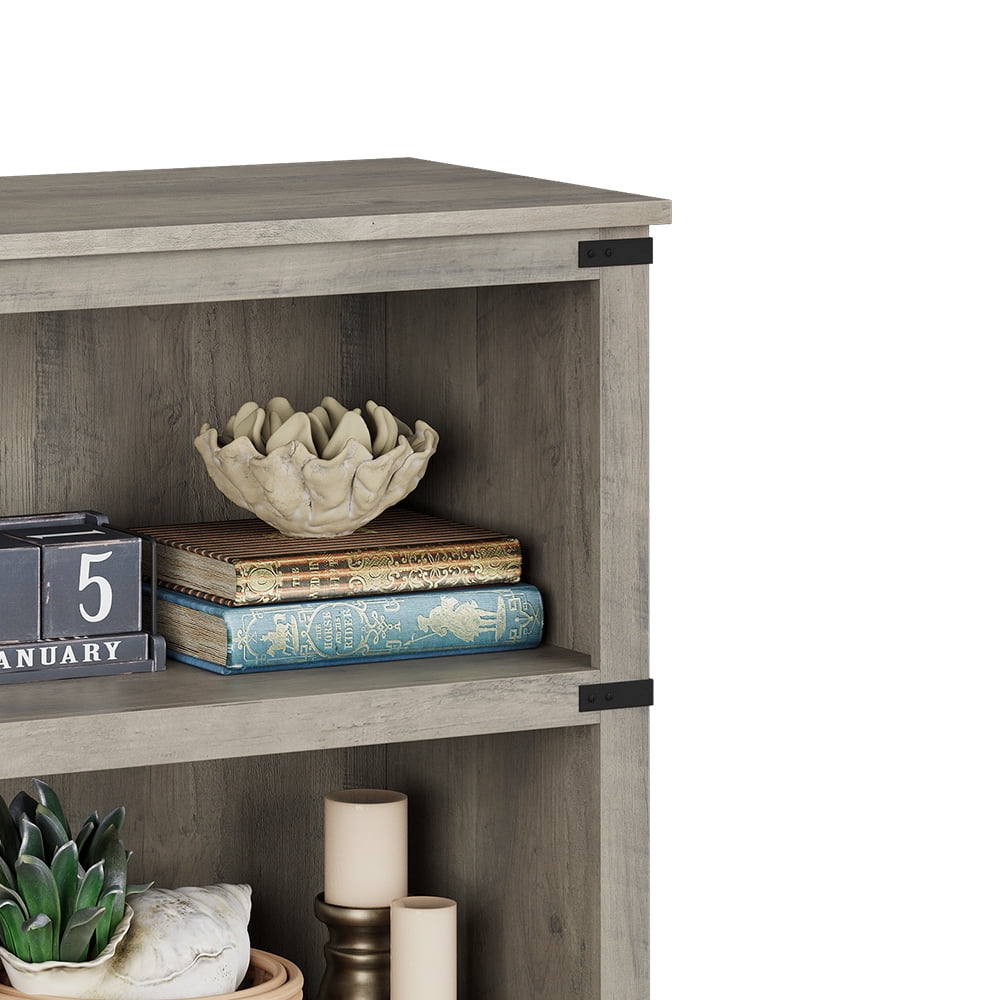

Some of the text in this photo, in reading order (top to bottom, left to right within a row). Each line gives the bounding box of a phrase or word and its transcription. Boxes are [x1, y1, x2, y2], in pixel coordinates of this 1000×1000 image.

[78, 551, 113, 623] 5
[323, 611, 334, 649] HORSE
[343, 608, 353, 649] RIDER
